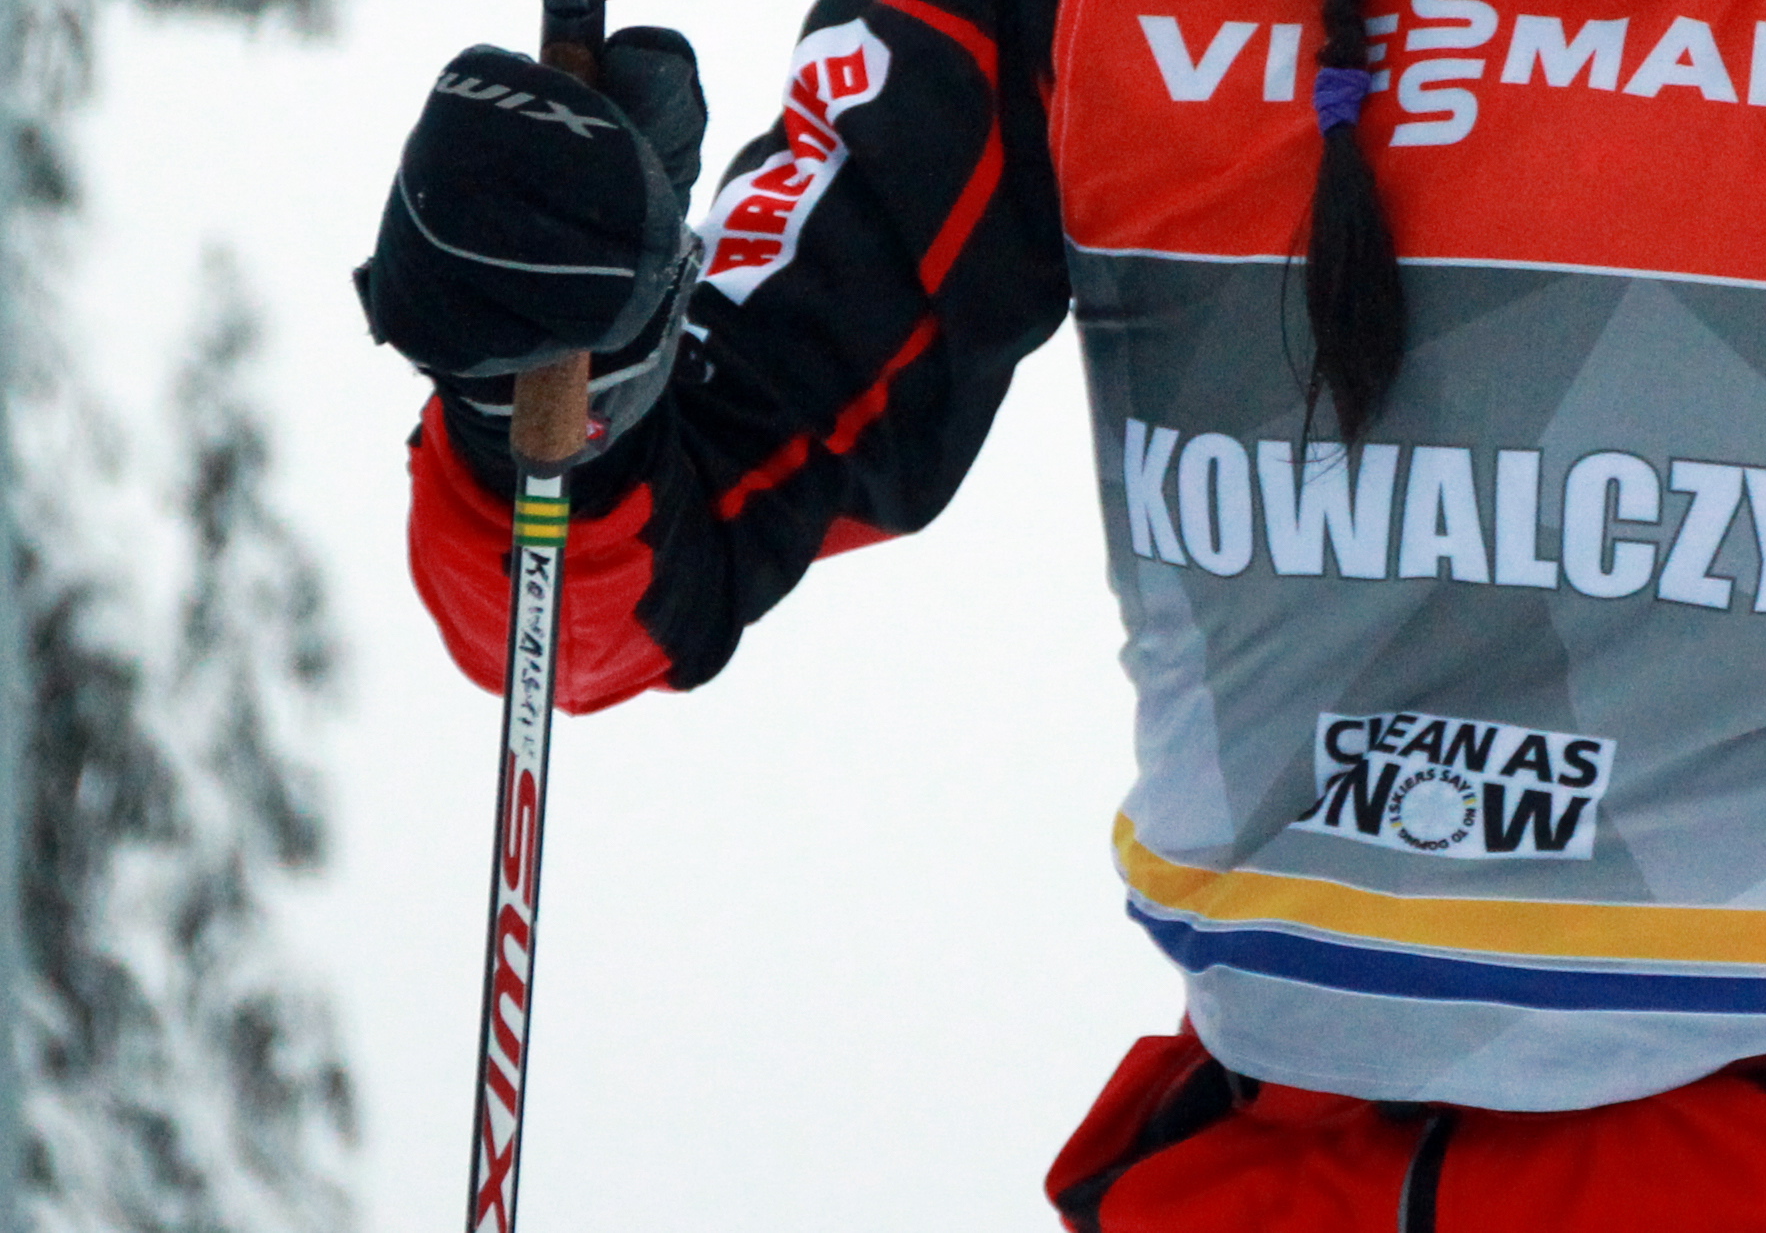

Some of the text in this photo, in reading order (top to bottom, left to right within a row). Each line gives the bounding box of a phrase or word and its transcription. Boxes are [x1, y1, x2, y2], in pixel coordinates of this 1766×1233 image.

[436, 71, 620, 139] WIX
[1324, 714, 1601, 789] CLEAN AS
[1388, 768, 1436, 814] SKIERS
[1440, 769, 1473, 793] SAY
